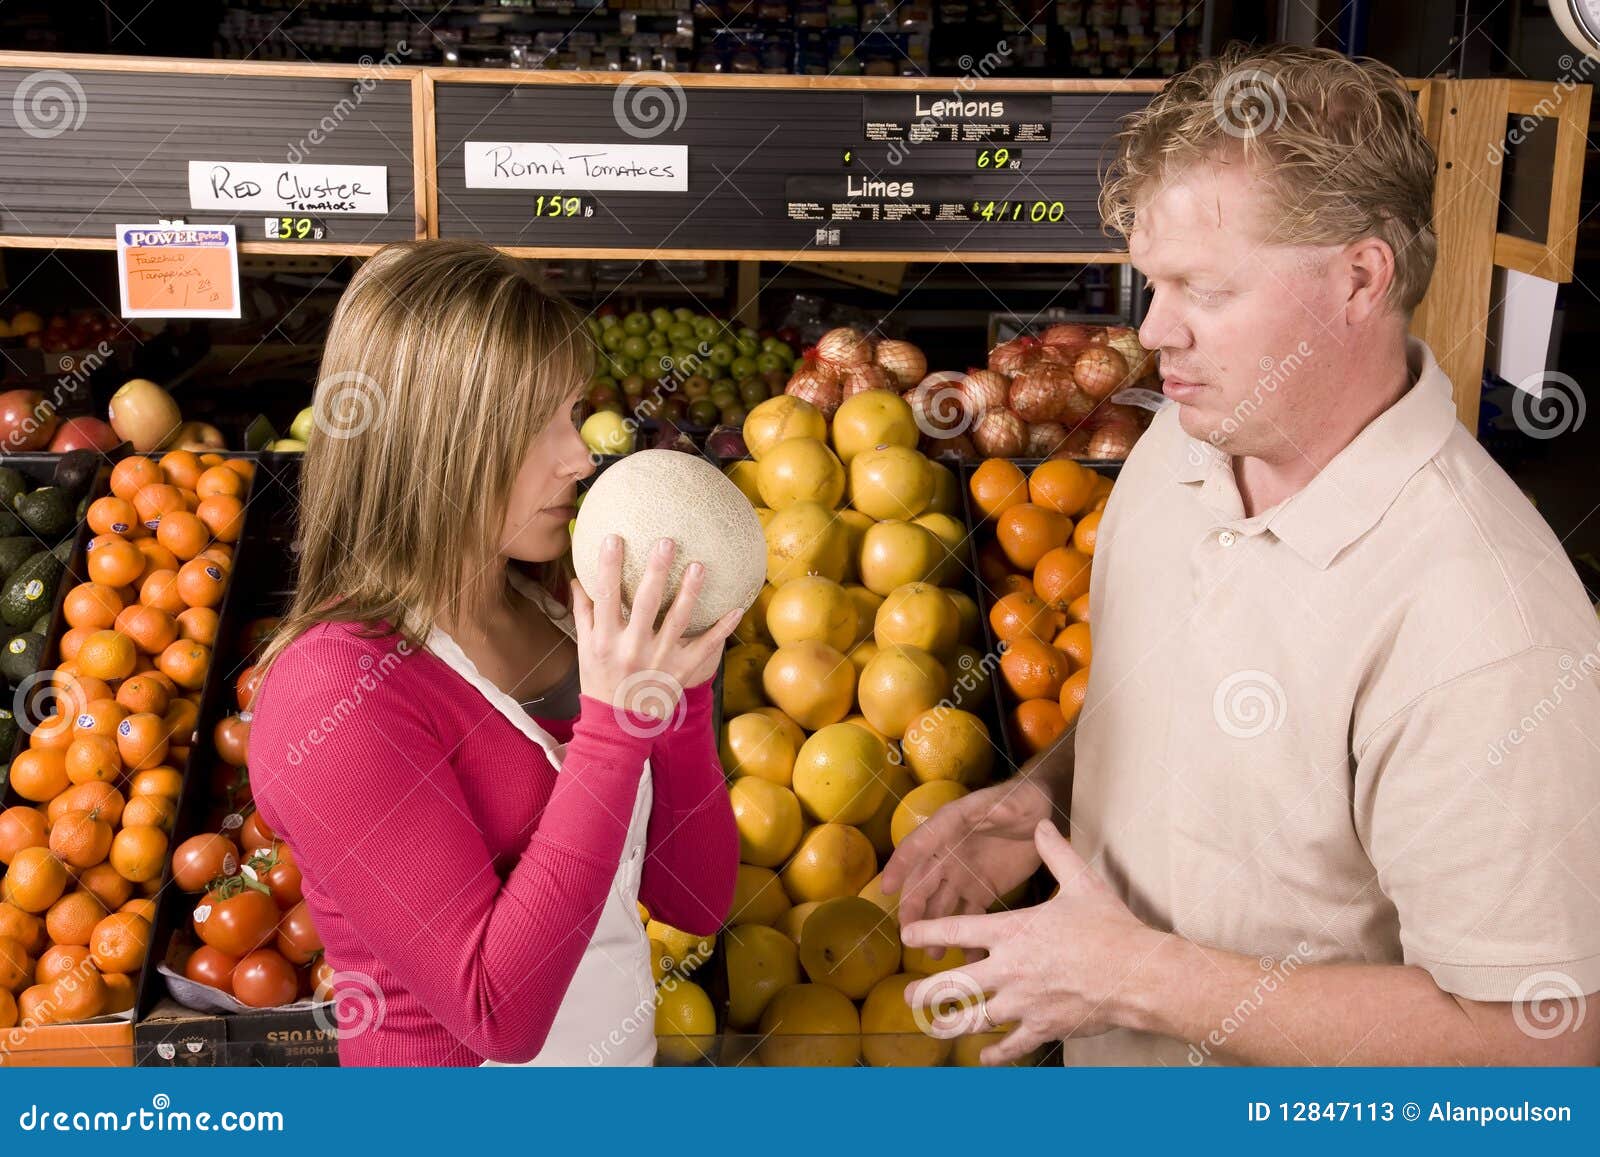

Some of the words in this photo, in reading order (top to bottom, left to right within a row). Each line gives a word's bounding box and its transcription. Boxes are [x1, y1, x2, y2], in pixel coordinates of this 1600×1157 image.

[915, 94, 1005, 117] Lemons
[977, 148, 1009, 169] 69
[847, 175, 915, 198] Limes
[535, 195, 580, 217] 159
[130, 230, 198, 248] POWER
